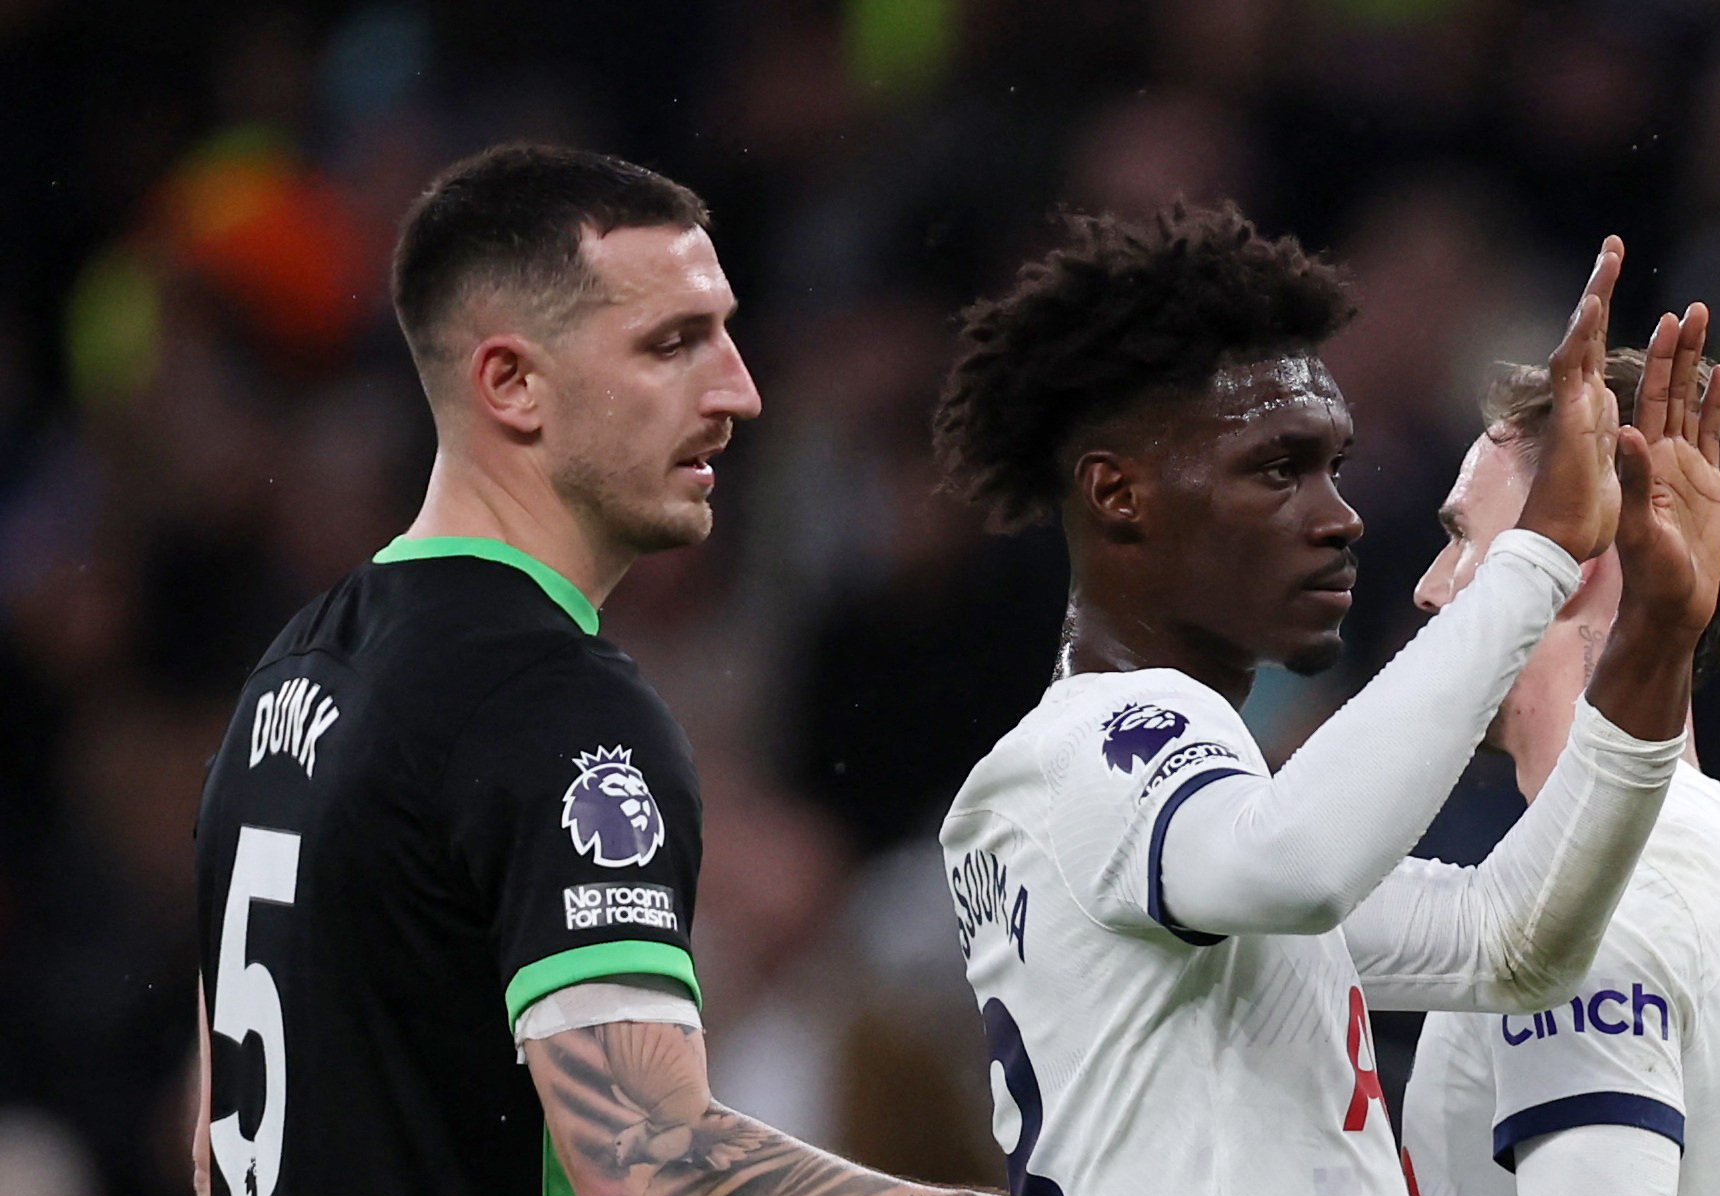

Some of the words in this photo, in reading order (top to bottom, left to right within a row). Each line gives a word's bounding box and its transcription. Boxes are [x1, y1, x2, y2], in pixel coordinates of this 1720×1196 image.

[249, 677, 340, 780] DUNK
[563, 886, 602, 911] No
[605, 887, 669, 910] room
[566, 907, 602, 930] for
[605, 906, 678, 932] racism
